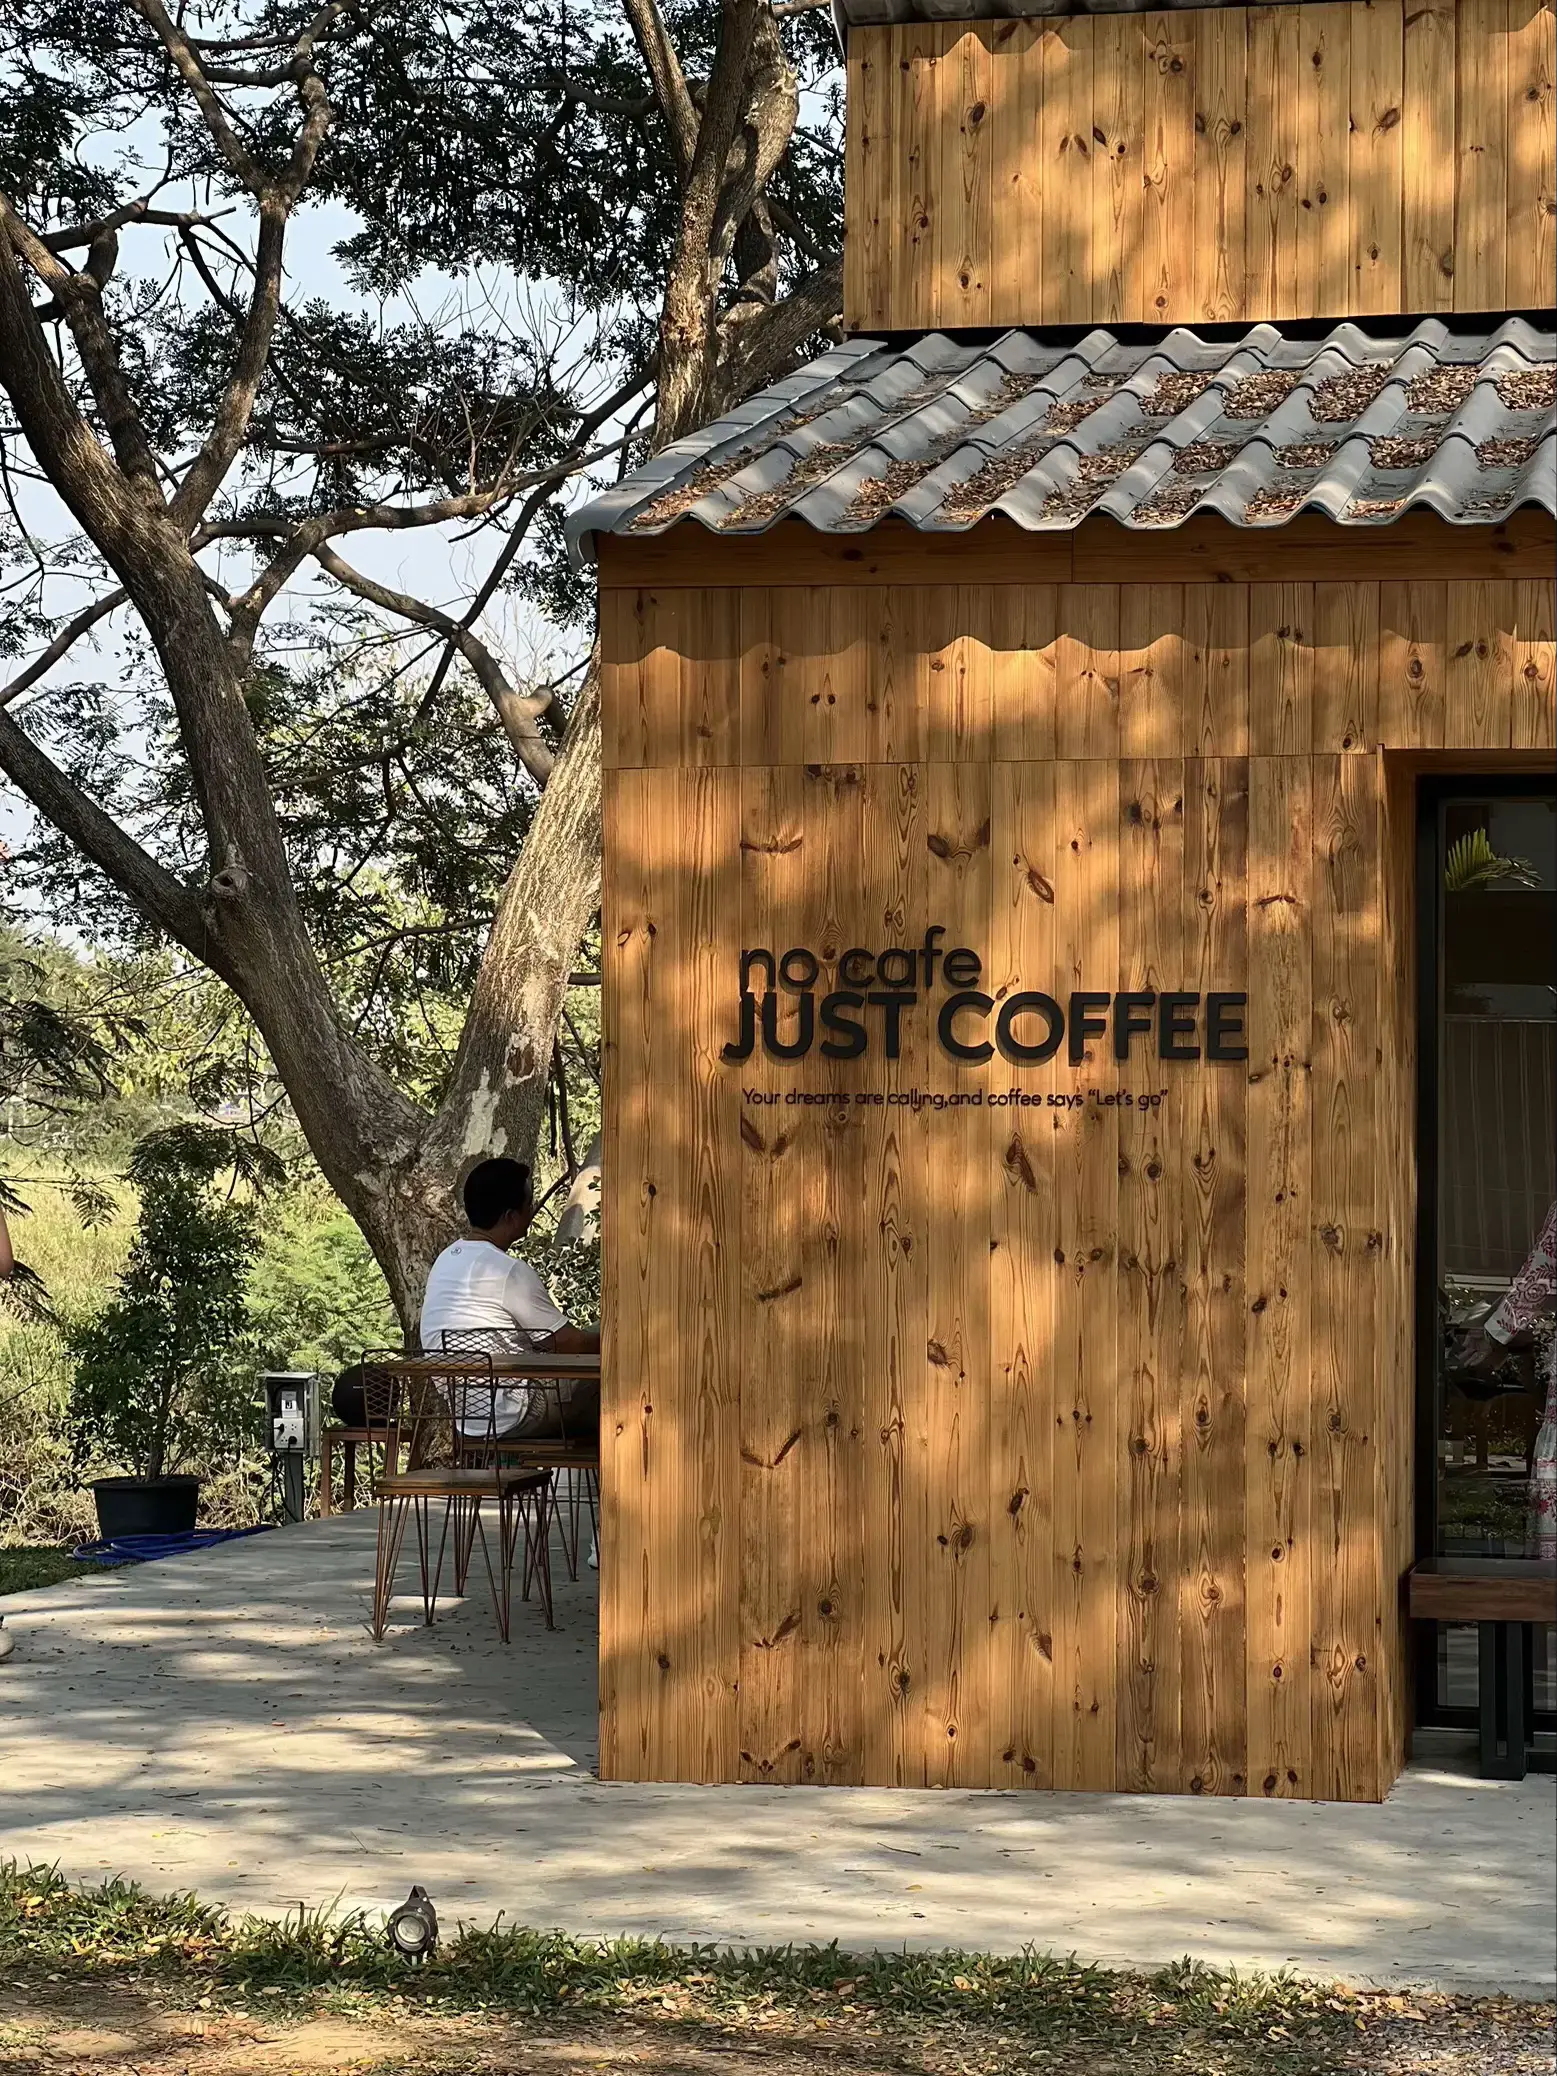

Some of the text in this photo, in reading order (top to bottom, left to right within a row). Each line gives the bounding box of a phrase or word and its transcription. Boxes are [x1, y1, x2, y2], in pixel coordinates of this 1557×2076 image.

[739, 925, 982, 988] no cafe
[723, 991, 1249, 1061] JUST COFFEE
[742, 1088, 781, 1105] Your
[785, 1088, 850, 1105] dreams
[855, 1093, 884, 1105] are
[988, 1088, 1042, 1106] coffee
[1047, 1093, 1084, 1110] says
